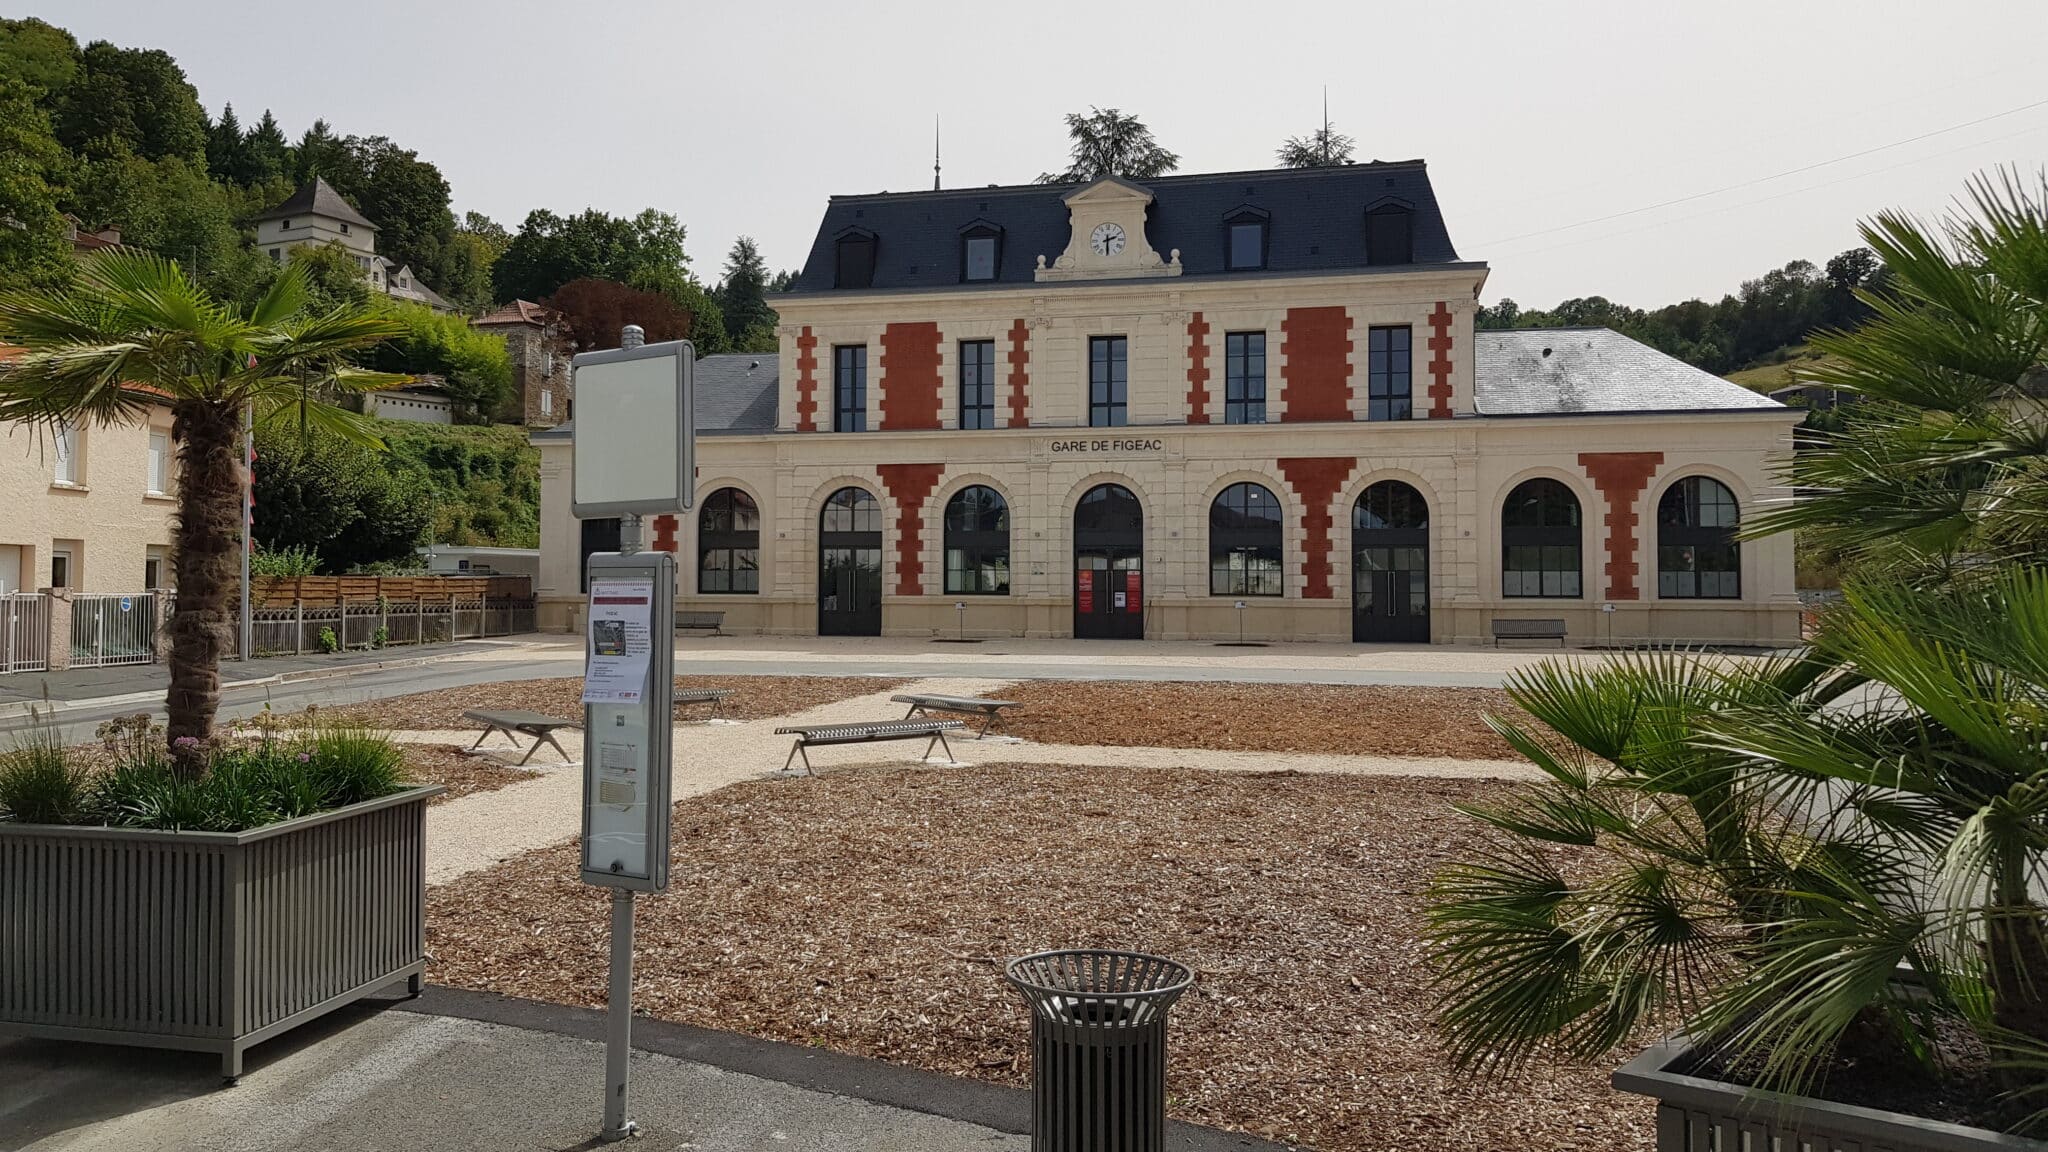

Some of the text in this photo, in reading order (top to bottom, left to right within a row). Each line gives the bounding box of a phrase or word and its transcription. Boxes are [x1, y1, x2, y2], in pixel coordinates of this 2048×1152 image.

[1051, 440, 1162, 452] GARE DE FIGEAC
